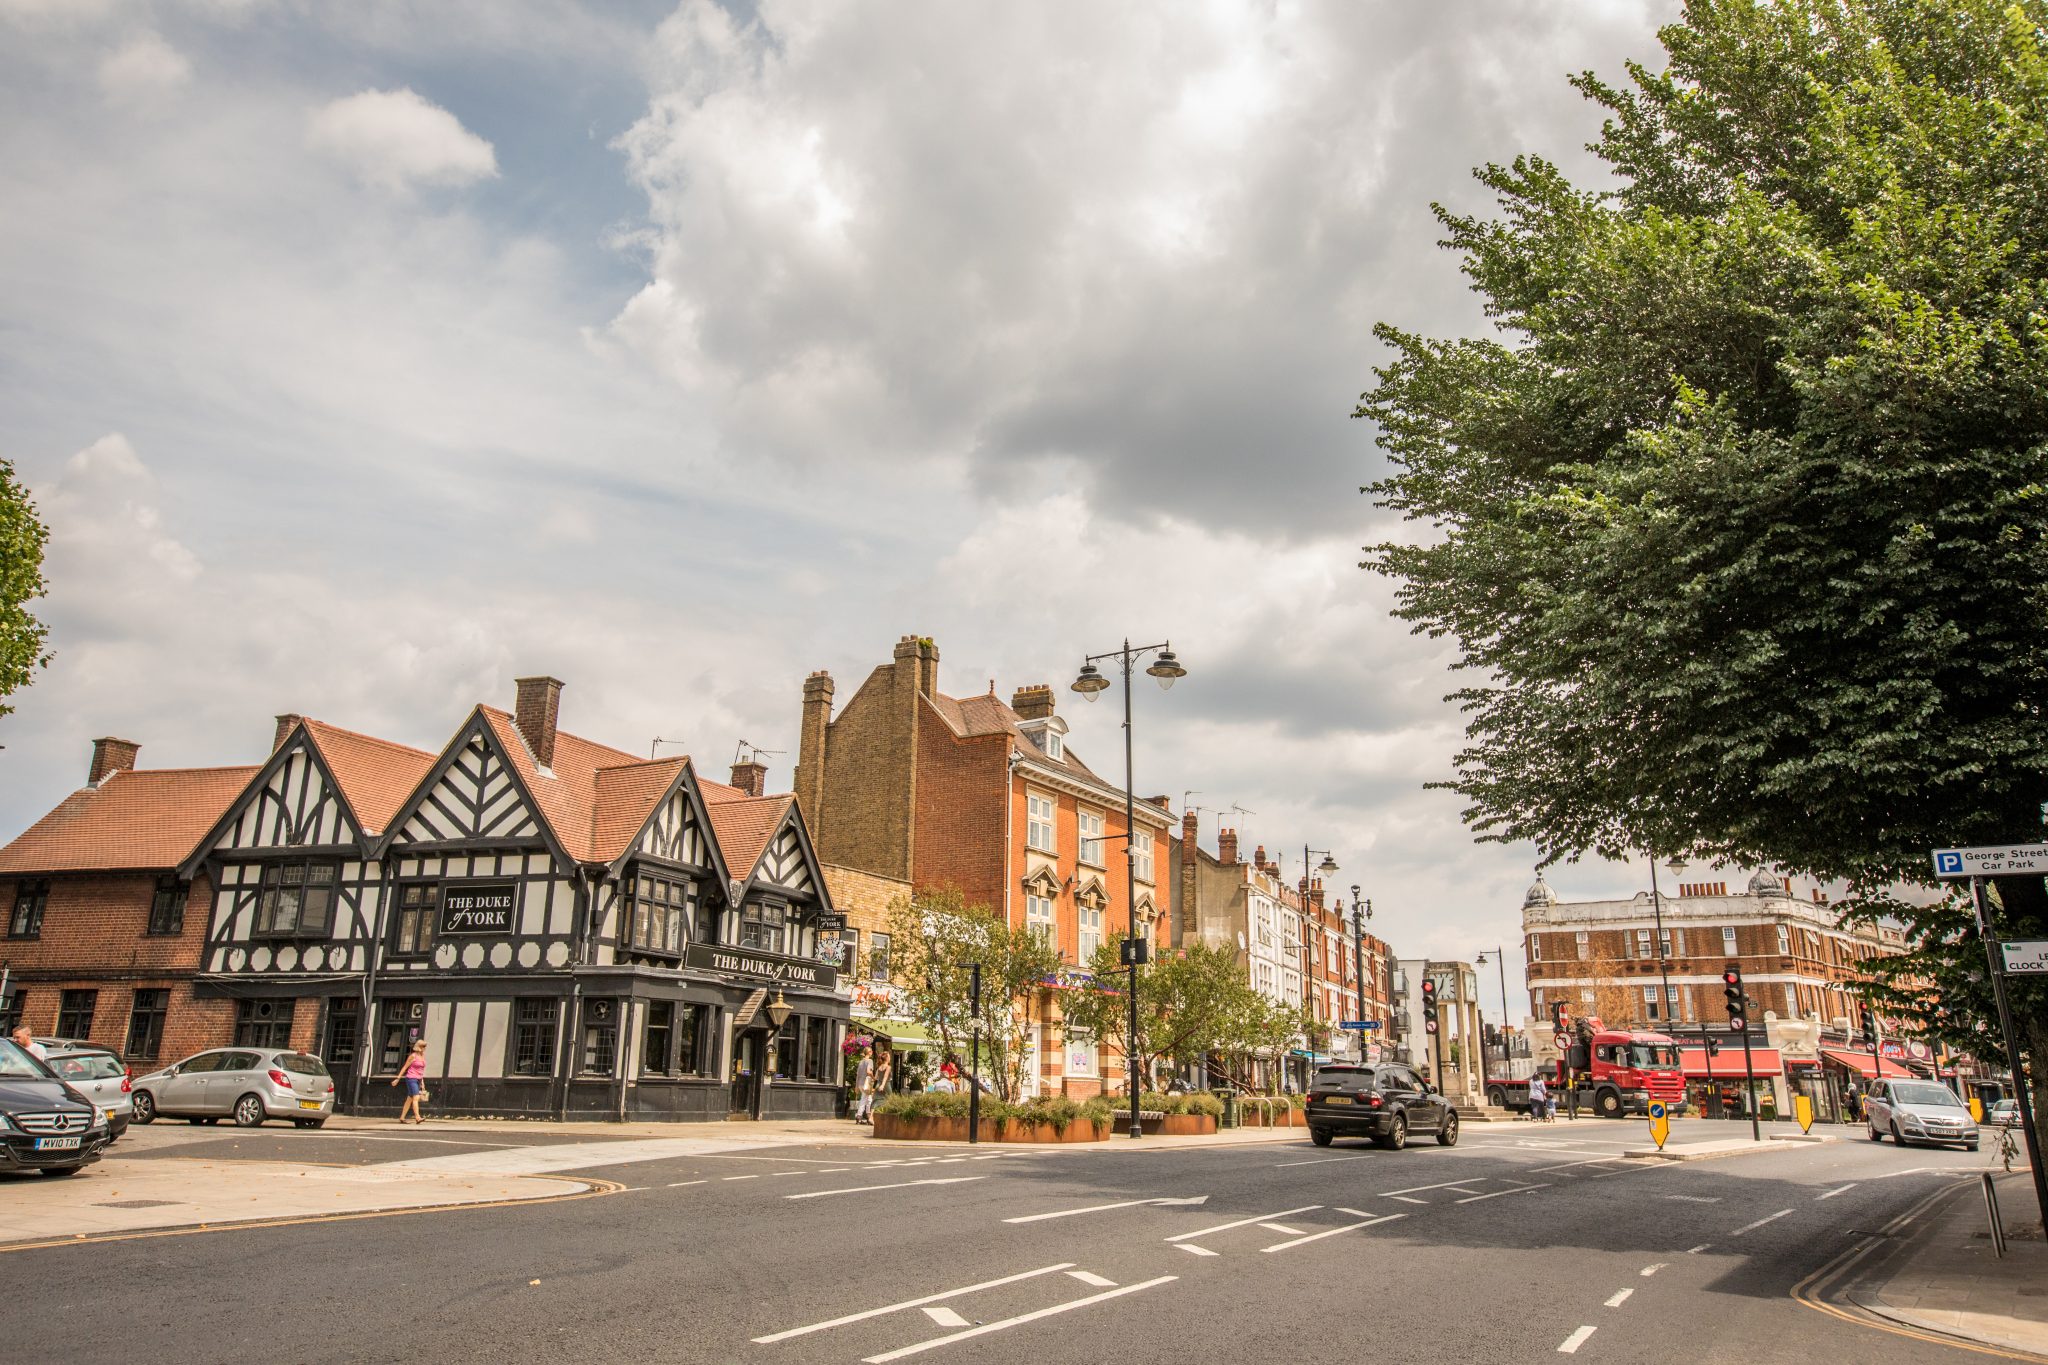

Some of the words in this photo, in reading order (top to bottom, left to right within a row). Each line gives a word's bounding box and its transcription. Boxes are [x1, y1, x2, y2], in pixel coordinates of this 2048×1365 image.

[1965, 851, 2005, 861] George
[2011, 848, 2048, 858] Street
[1943, 855, 1958, 871] P
[1982, 862, 2001, 870] Car
[2008, 860, 2035, 869] Park
[448, 897, 474, 909] THE
[475, 896, 511, 908] DUKE
[447, 908, 470, 930] of
[466, 911, 506, 925] YORK
[713, 953, 739, 971] THE
[740, 958, 774, 976] DUKE
[772, 963, 787, 980] of
[787, 965, 816, 981] YORK
[2009, 962, 2044, 970] CLOCK
[43, 1139, 64, 1148] MV10
[65, 1138, 79, 1147] TXK
